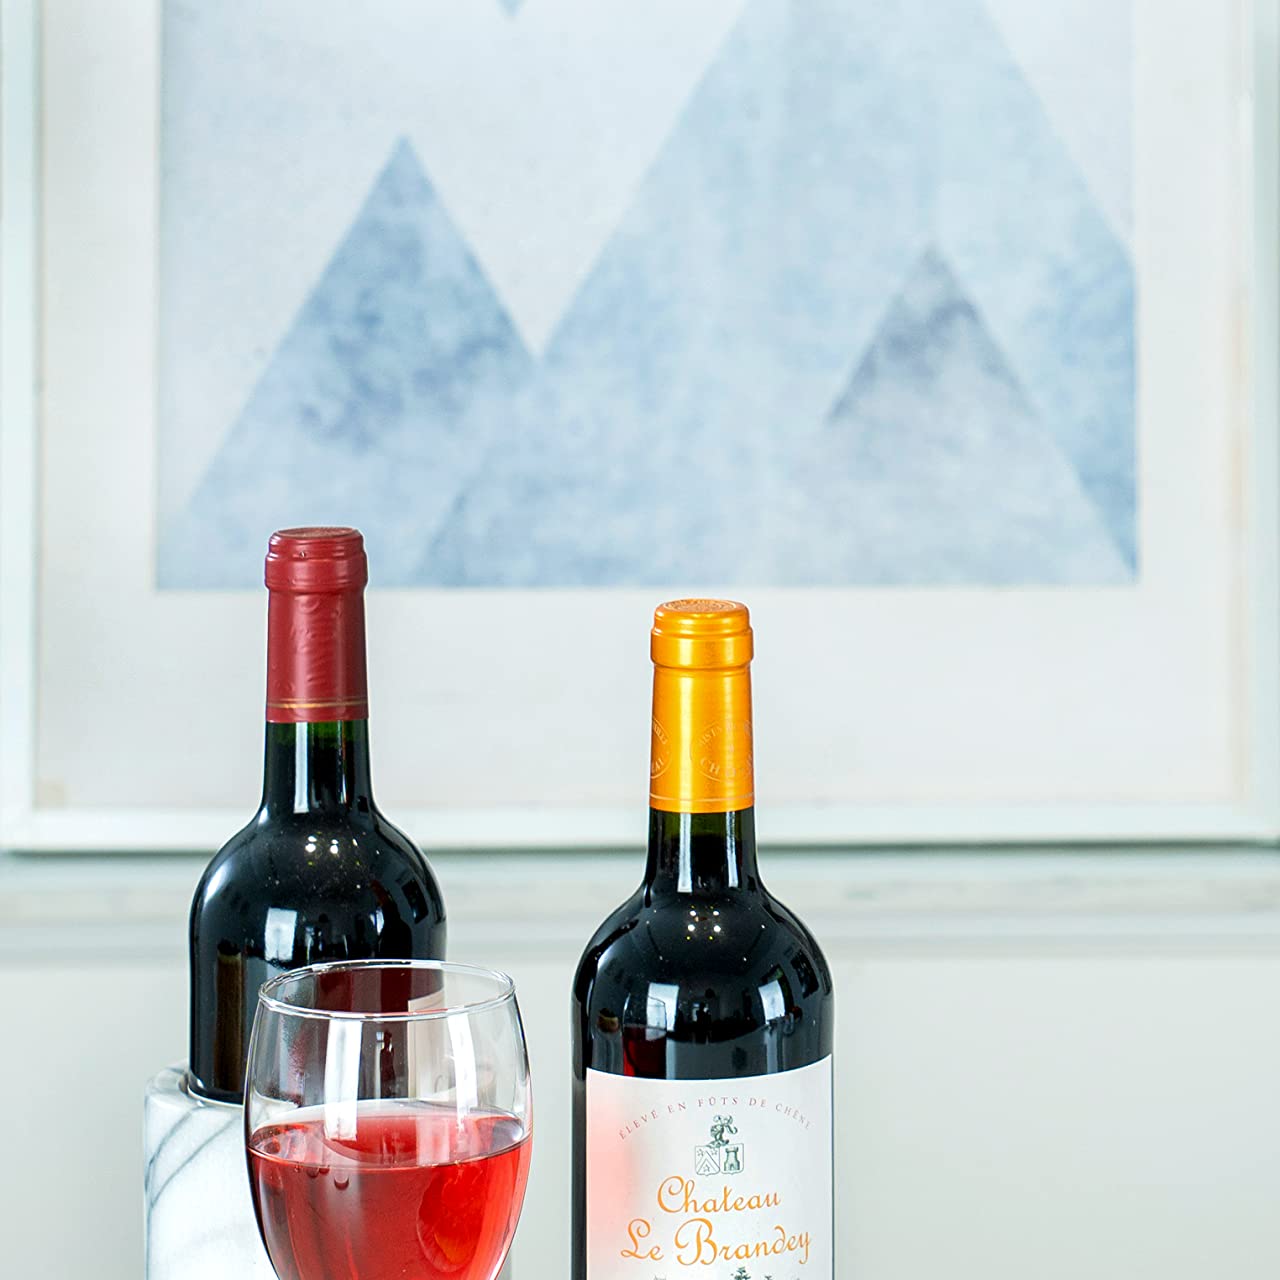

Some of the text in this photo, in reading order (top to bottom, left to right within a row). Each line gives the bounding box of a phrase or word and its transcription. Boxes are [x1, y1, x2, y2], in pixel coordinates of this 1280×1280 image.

[667, 1103, 687, 1114] EN
[749, 1098, 767, 1108] DE
[657, 1175, 781, 1213] Chateau
[620, 1217, 811, 1266] Le Brandey
